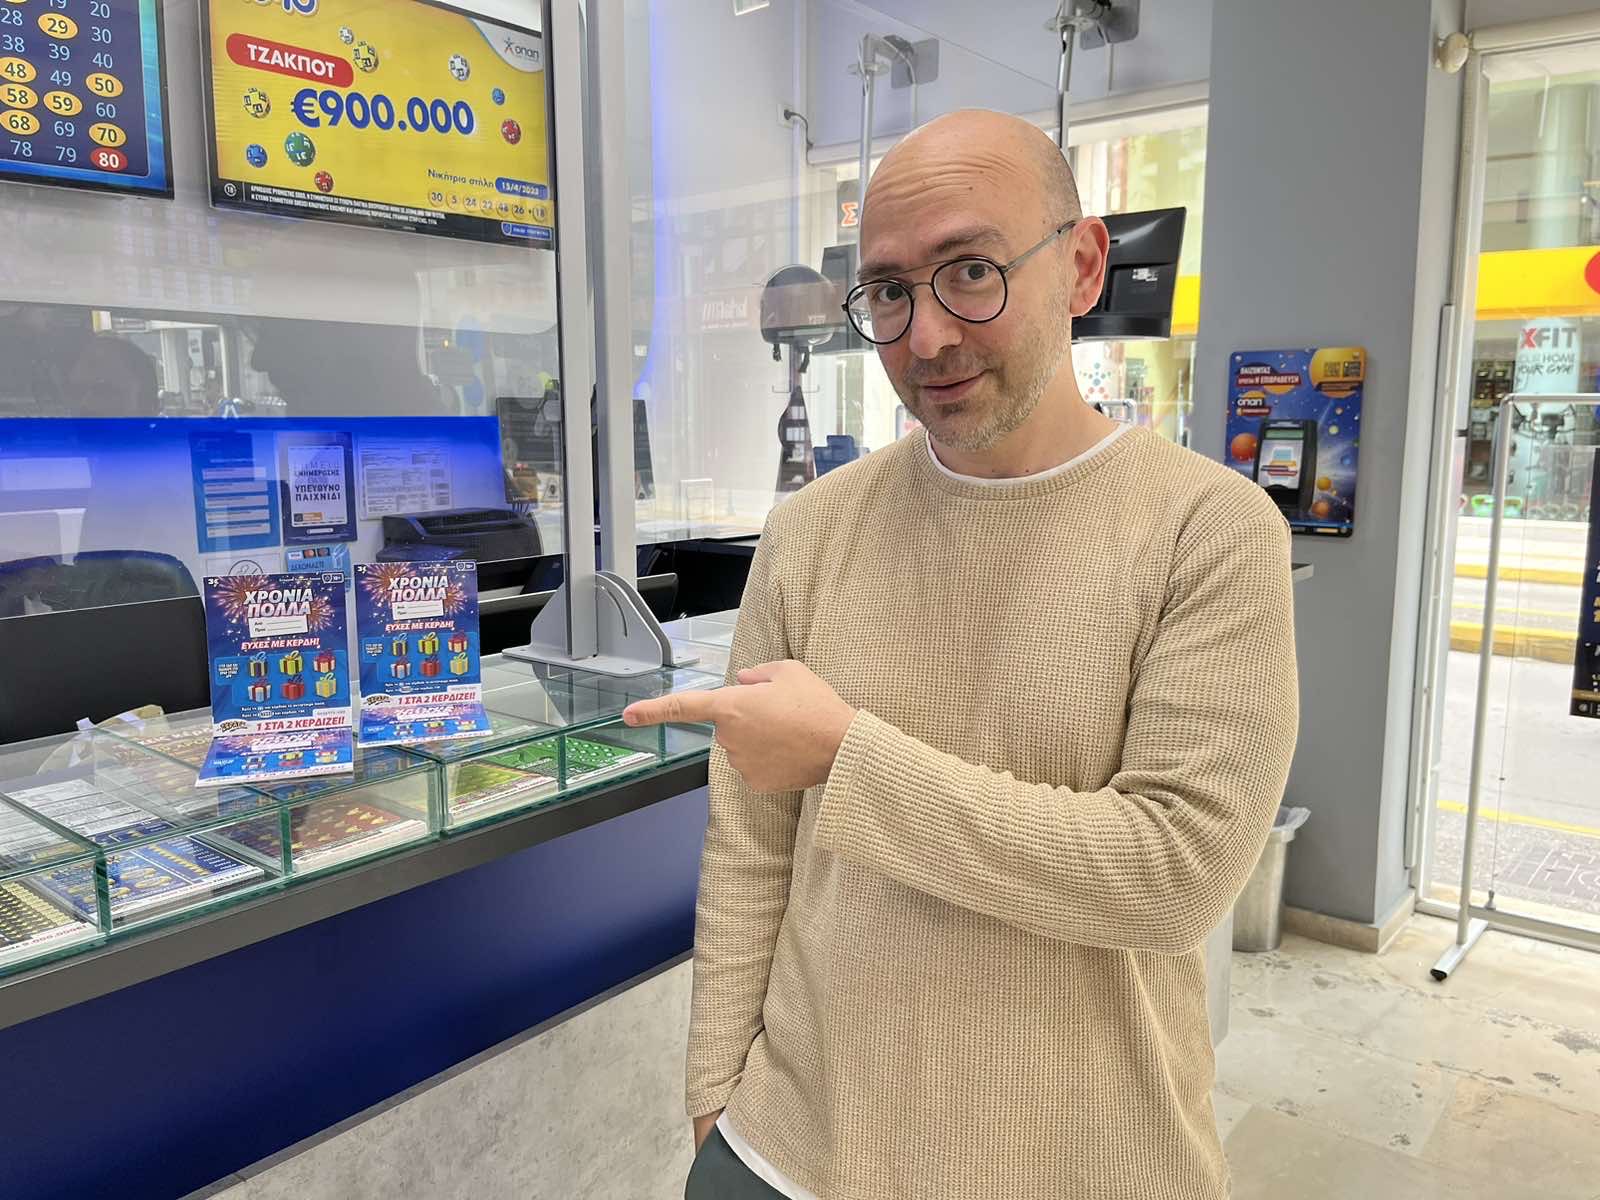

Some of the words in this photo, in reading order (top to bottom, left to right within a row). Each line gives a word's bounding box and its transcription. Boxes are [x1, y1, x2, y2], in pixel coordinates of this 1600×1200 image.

[89, 1, 110, 19] 20
[0, 7, 23, 26] 28
[47, 17, 68, 35] 29
[91, 26, 112, 44] 30
[2, 34, 25, 53] 38
[48, 43, 70, 61] 39
[92, 52, 113, 69] 40
[247, 43, 336, 79] ΤΖΑΚΠΟΤ
[4, 62, 27, 79] 48
[50, 69, 72, 87] 49
[95, 77, 114, 93] 50
[7, 87, 29, 105] 58
[52, 95, 73, 112] 59
[96, 102, 116, 119] 60
[291, 88, 475, 135] €900.000
[9, 114, 31, 131] 68
[54, 120, 75, 137] 69
[97, 127, 118, 143] 70
[10, 139, 33, 157] 78
[56, 145, 77, 163] 79
[98, 152, 120, 169] 80
[431, 192, 443, 201] 30
[1520, 327, 1577, 349] XFIT
[295, 492, 341, 502] ΠΑΙΧΝΙΔΙ
[388, 575, 449, 590] ΧΡΟΝΙΑ
[244, 588, 314, 605] ΧΡΟΝΙΑ
[391, 588, 447, 602] ΠΟΛΛΑ
[247, 601, 312, 618] ΠΟΛΛΑ
[385, 623, 410, 632] ΕΥΧΕΣ
[411, 622, 424, 631] ΜΕ
[241, 639, 270, 650] ΕΥΧΕΣ
[271, 639, 286, 649] ΜΕ
[405, 696, 423, 705] ΣΤΑ
[256, 723, 262, 731] 1
[263, 721, 284, 731] ΣΤΑ
[287, 720, 294, 729] 2
